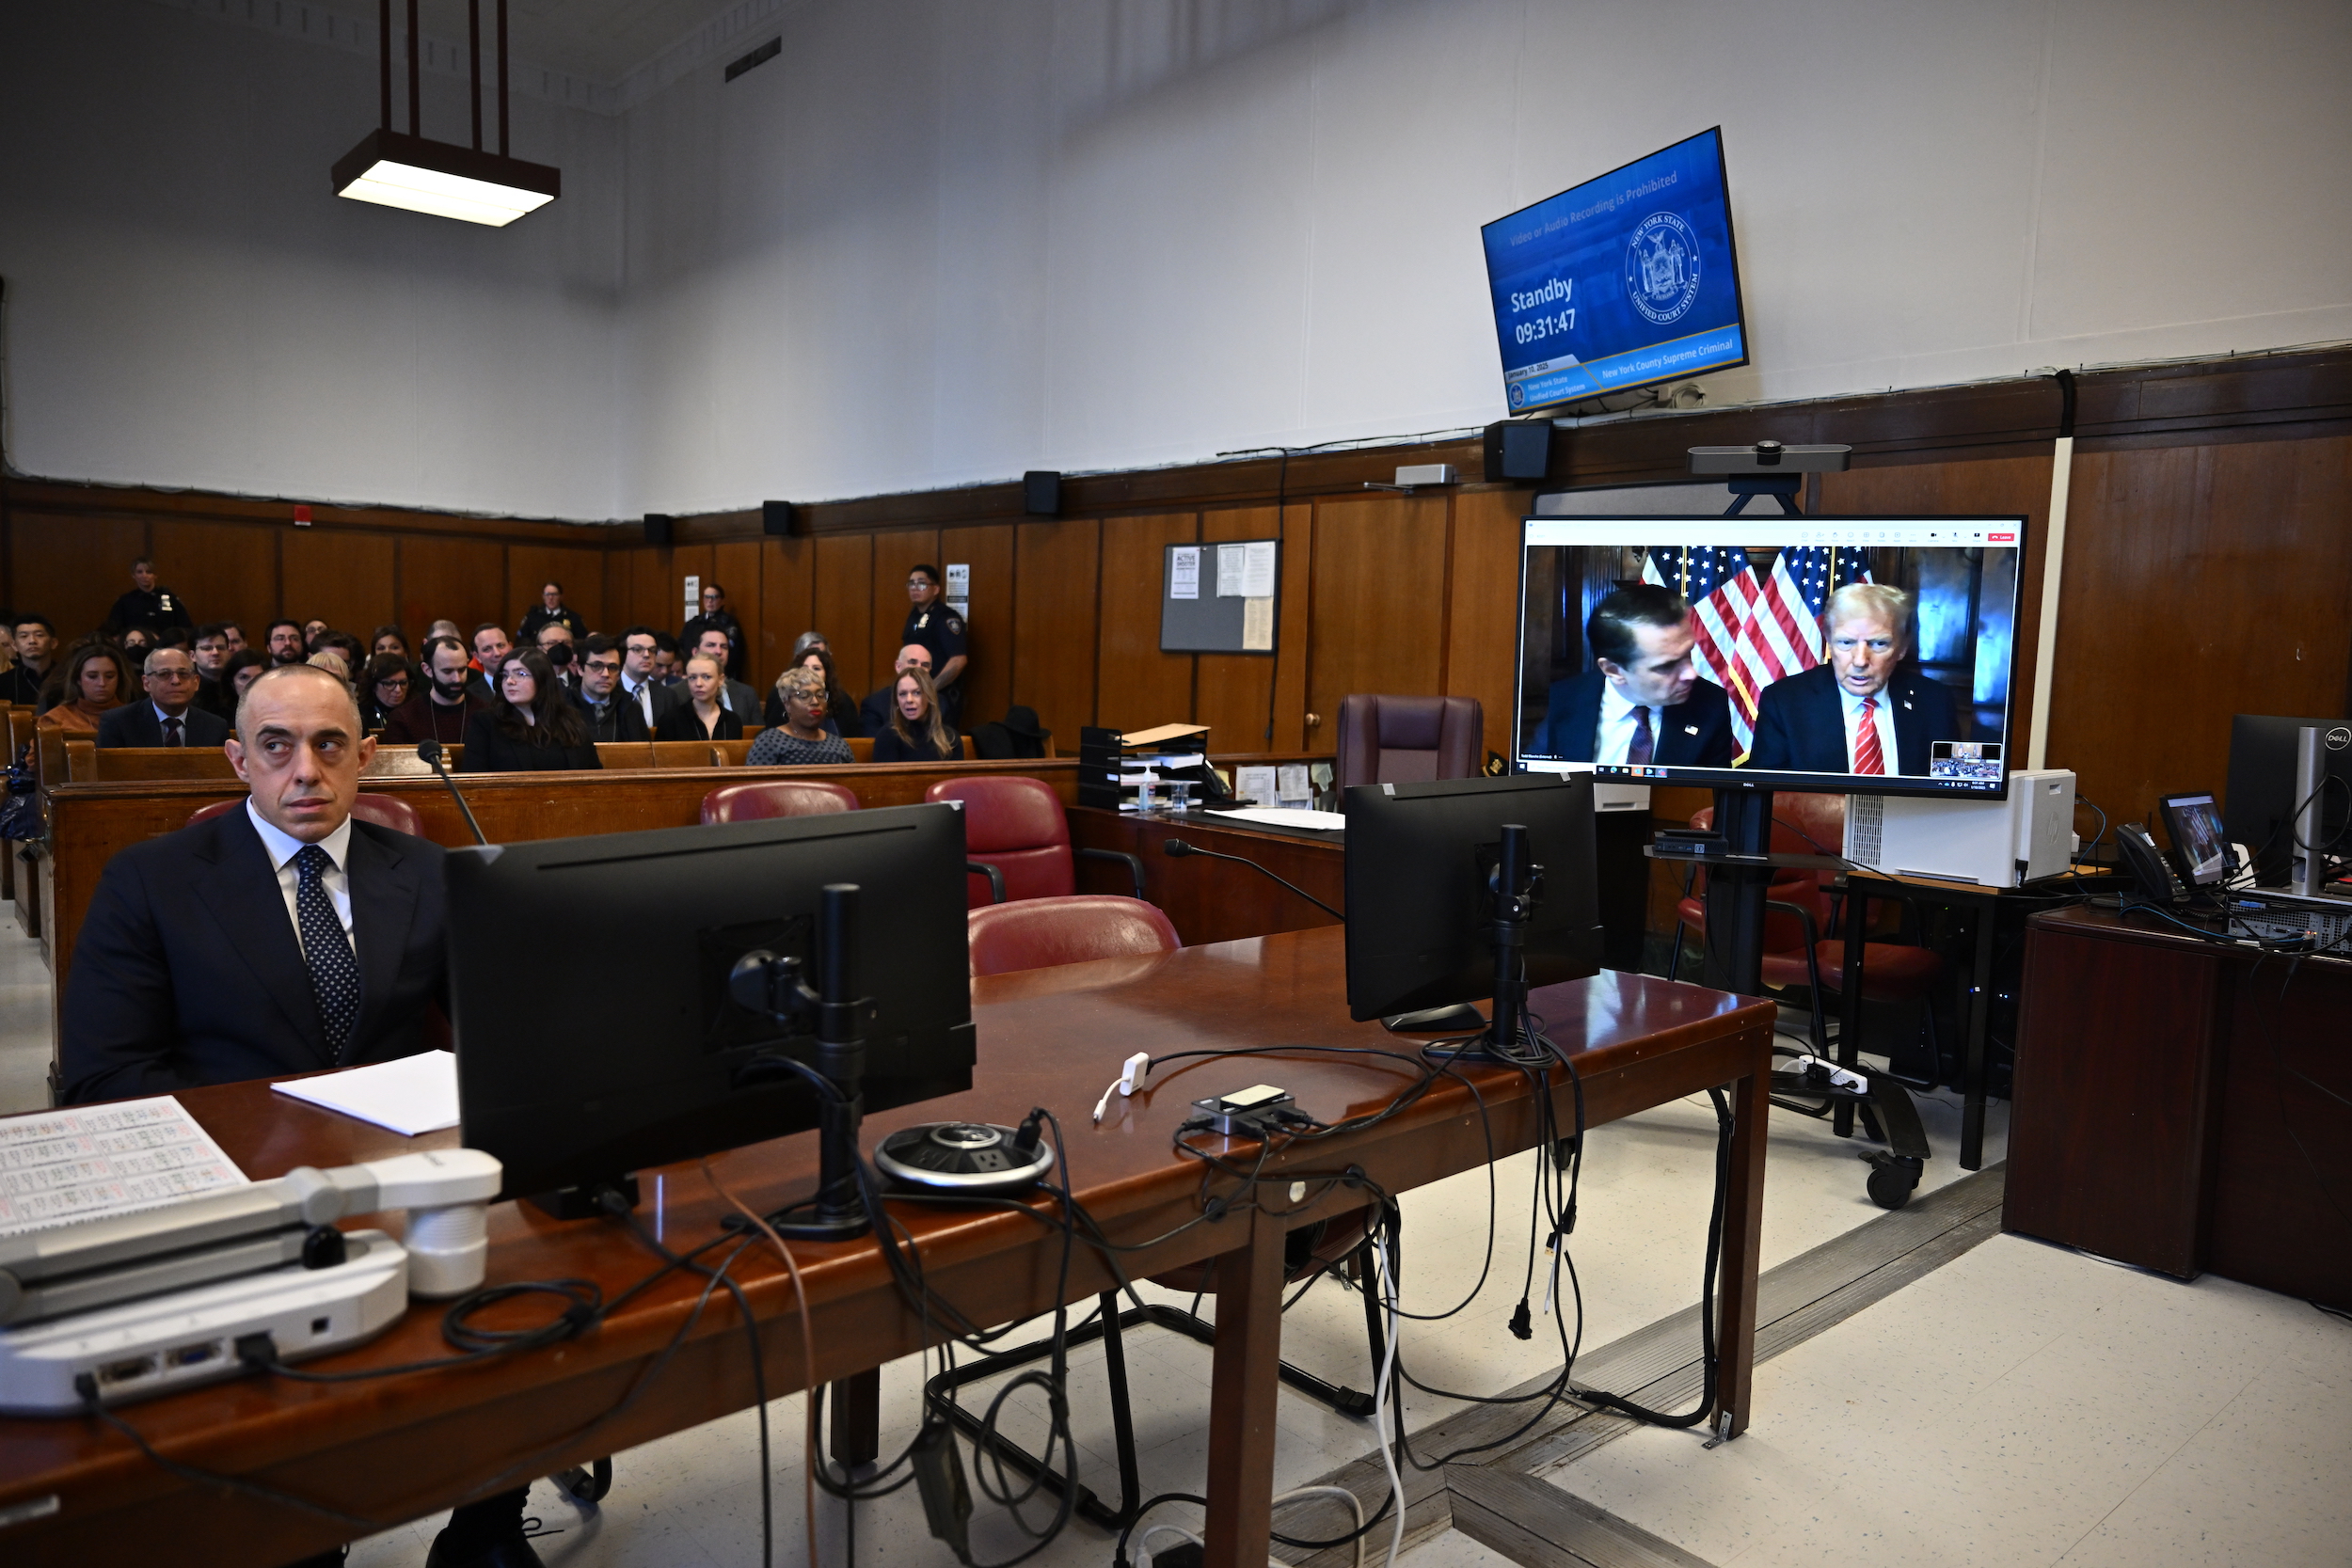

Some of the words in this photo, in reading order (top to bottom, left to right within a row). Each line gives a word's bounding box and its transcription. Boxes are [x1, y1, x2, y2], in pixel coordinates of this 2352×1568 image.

[1510, 230, 1533, 246] Video
[1534, 227, 1543, 237] or
[1545, 217, 1568, 234] Audio
[1570, 198, 1615, 224] Recording
[1617, 194, 1624, 206] is
[1626, 170, 1677, 202] Prohibited
[1631, 228, 1645, 248] NEW
[1644, 215, 1662, 230] YORK
[1664, 215, 1685, 232] STATE
[1511, 277, 1572, 313] Standby
[1632, 291, 1657, 321] UNIFIED
[1658, 309, 1681, 322] COURT
[1681, 273, 1698, 309] SYSTEM
[1516, 308, 1576, 344] 09:31:47
[1507, 368, 1529, 380] January
[1536, 362, 1549, 372] 2025
[1602, 368, 1618, 379] New
[1619, 363, 1635, 376] York
[1637, 356, 1661, 371] County
[1662, 349, 1697, 365] Supreme
[1698, 339, 1733, 356] Criminal
[1528, 382, 1540, 391] New
[1540, 379, 1552, 388] York
[1553, 376, 1568, 386] State
[1530, 390, 1549, 402] Unified
[1549, 388, 1565, 398] Court
[1565, 384, 1586, 395] System
